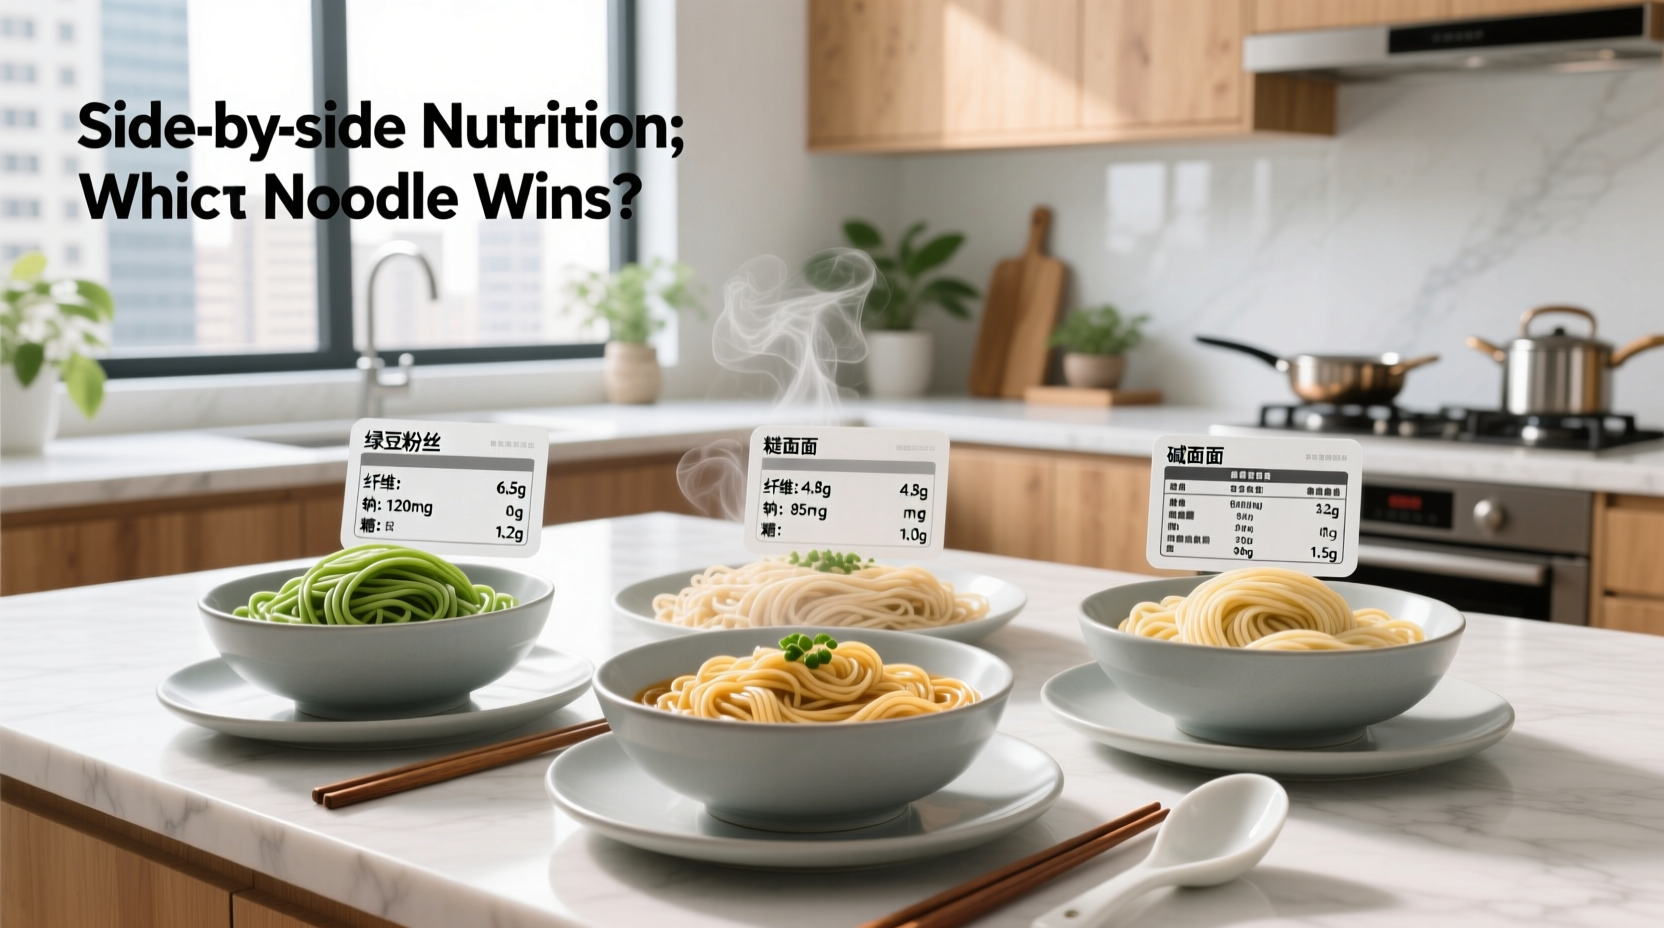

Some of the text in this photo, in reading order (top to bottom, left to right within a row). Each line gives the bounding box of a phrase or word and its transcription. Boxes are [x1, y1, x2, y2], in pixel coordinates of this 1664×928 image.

[364, 429, 441, 452] 绿豆粉丝
[496, 481, 526, 499] 6.5g
[386, 499, 433, 517] 120mg
[505, 505, 524, 521] 0g
[903, 508, 926, 523] mg
[496, 525, 524, 543] 1.2g
[900, 528, 927, 545] 1.0g
[1310, 546, 1338, 563] 1.5g
